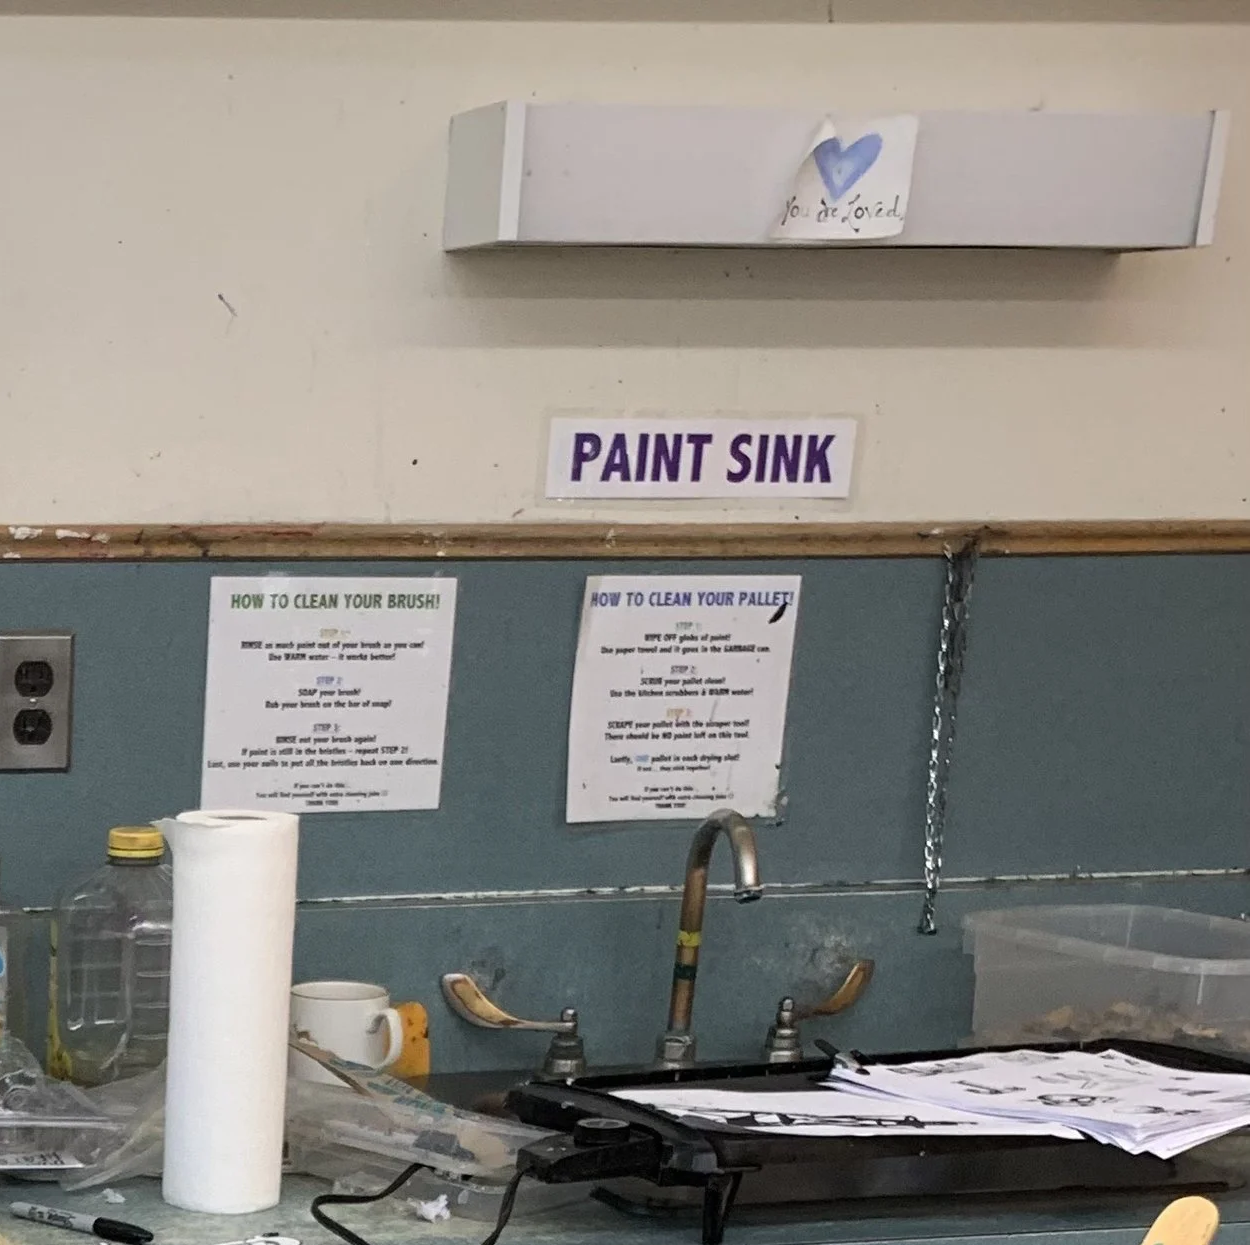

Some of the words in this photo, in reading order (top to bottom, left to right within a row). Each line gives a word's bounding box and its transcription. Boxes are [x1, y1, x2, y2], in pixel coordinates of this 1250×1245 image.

[570, 433, 713, 482] PAINT
[726, 434, 836, 483] SINK
[230, 594, 263, 608] HOW
[271, 594, 288, 608] TO
[294, 594, 338, 608] CLEAN
[344, 594, 382, 608] YOUR
[387, 594, 440, 608] BRUSH!
[588, 592, 620, 606] HOW
[626, 592, 644, 606] TO
[648, 592, 692, 606] CLEAN
[698, 592, 734, 605] YOUR
[738, 591, 793, 606] PALLET!
